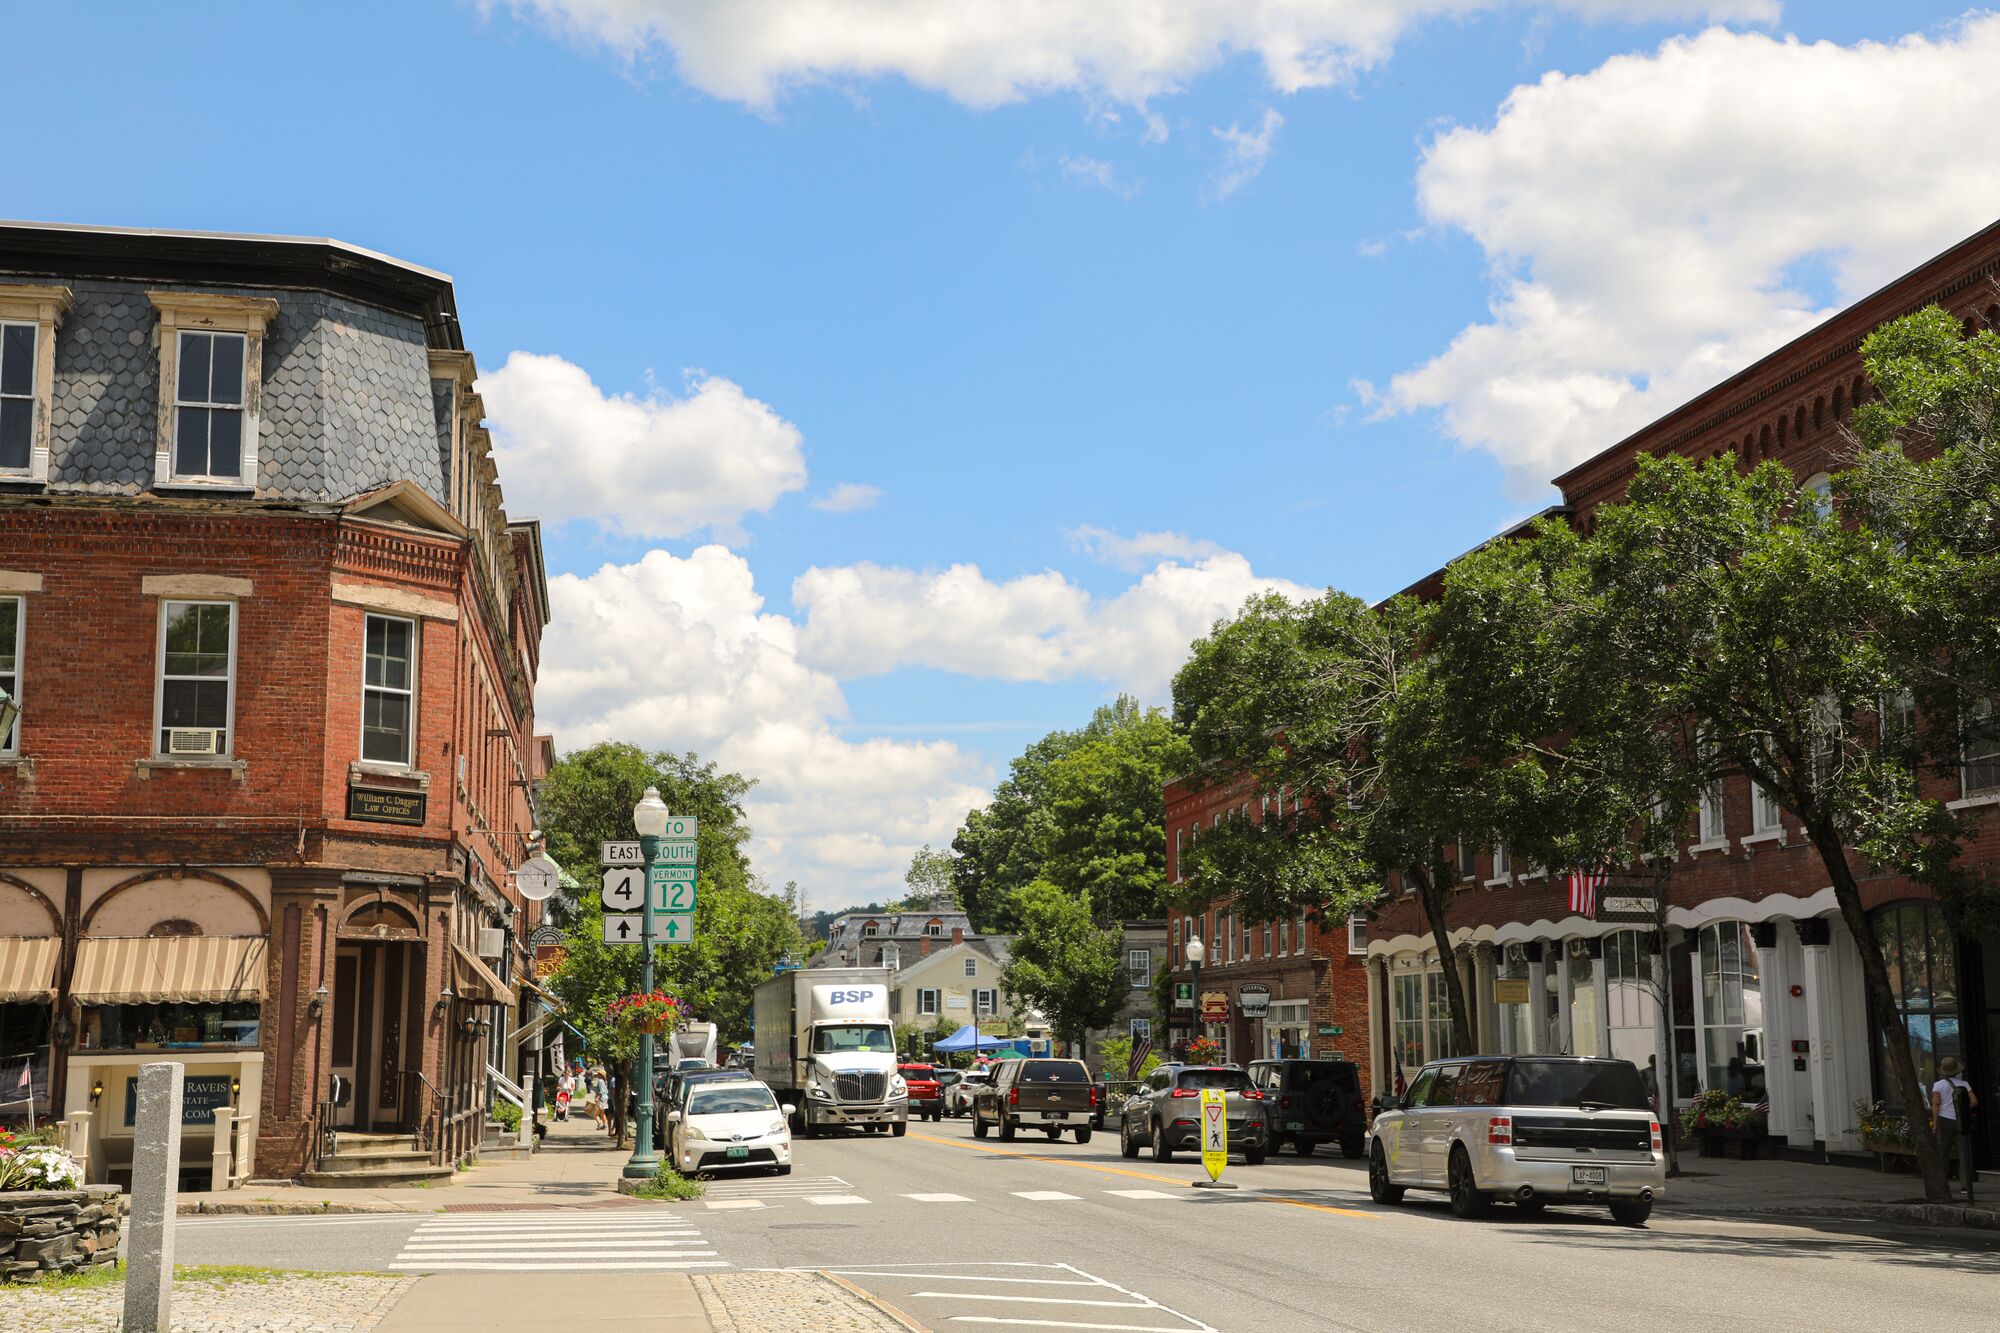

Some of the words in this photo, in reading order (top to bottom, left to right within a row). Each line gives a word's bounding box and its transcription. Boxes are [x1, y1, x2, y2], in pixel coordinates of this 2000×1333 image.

[356, 793, 385, 804] William
[386, 796, 393, 805] C.
[394, 797, 419, 808] Dagger
[364, 803, 380, 812] LAW
[666, 821, 684, 834] TO
[610, 846, 640, 859] EAST
[654, 846, 694, 859] SOUTH
[653, 870, 693, 879] VERMONT
[614, 876, 632, 901] 4
[661, 883, 684, 908] 12
[830, 990, 874, 1005] BSP
[187, 1082, 227, 1093] RAVEIS
[182, 1096, 209, 1105] STATE
